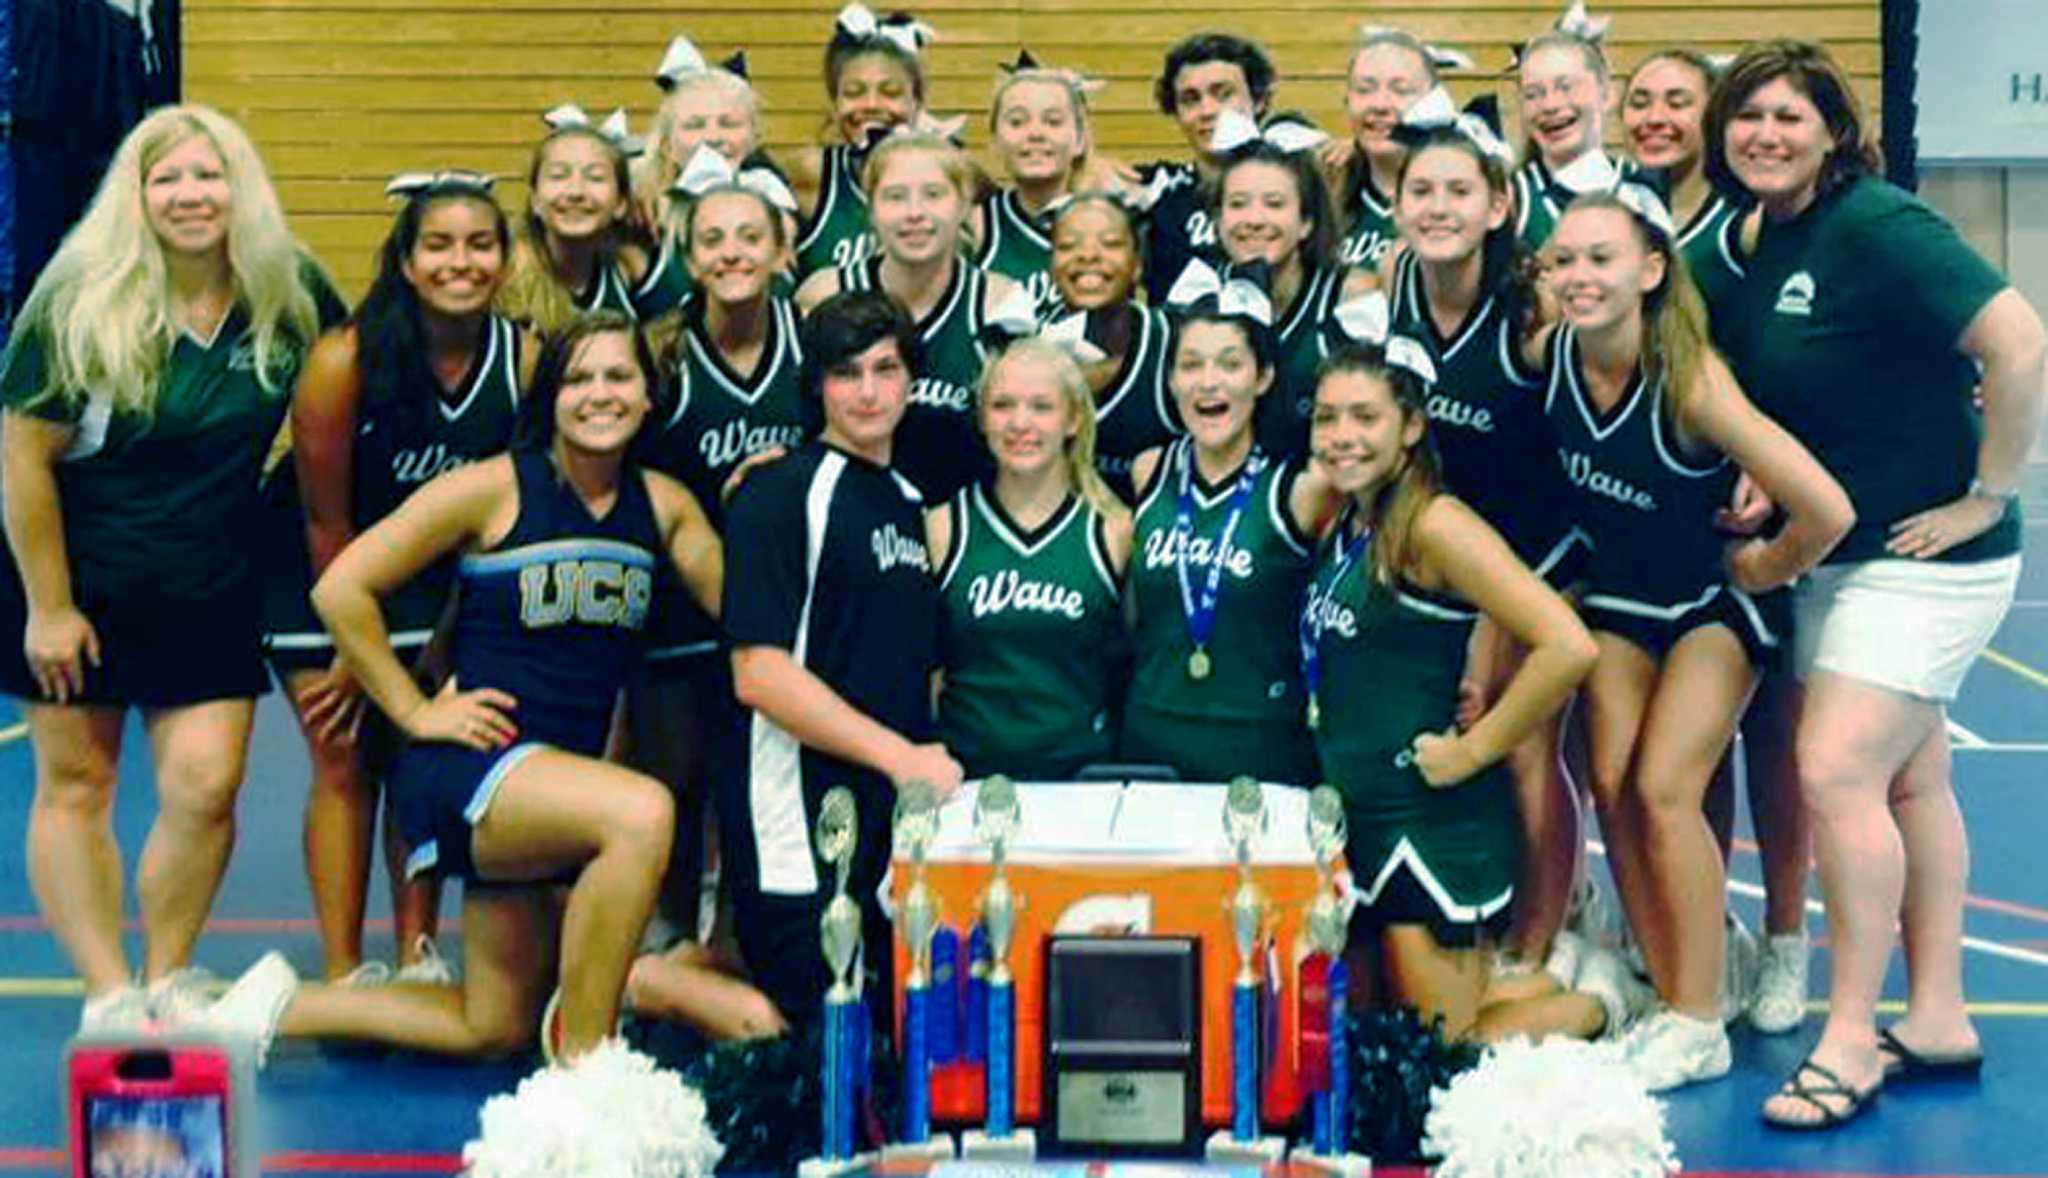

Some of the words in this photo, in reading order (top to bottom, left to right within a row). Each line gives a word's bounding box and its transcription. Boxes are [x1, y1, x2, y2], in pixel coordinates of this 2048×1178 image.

[2010, 73, 2048, 103] H
[905, 378, 971, 411] ave
[1424, 382, 1496, 433] ave
[1558, 447, 1658, 512] Wave
[968, 568, 1085, 620] Wave
